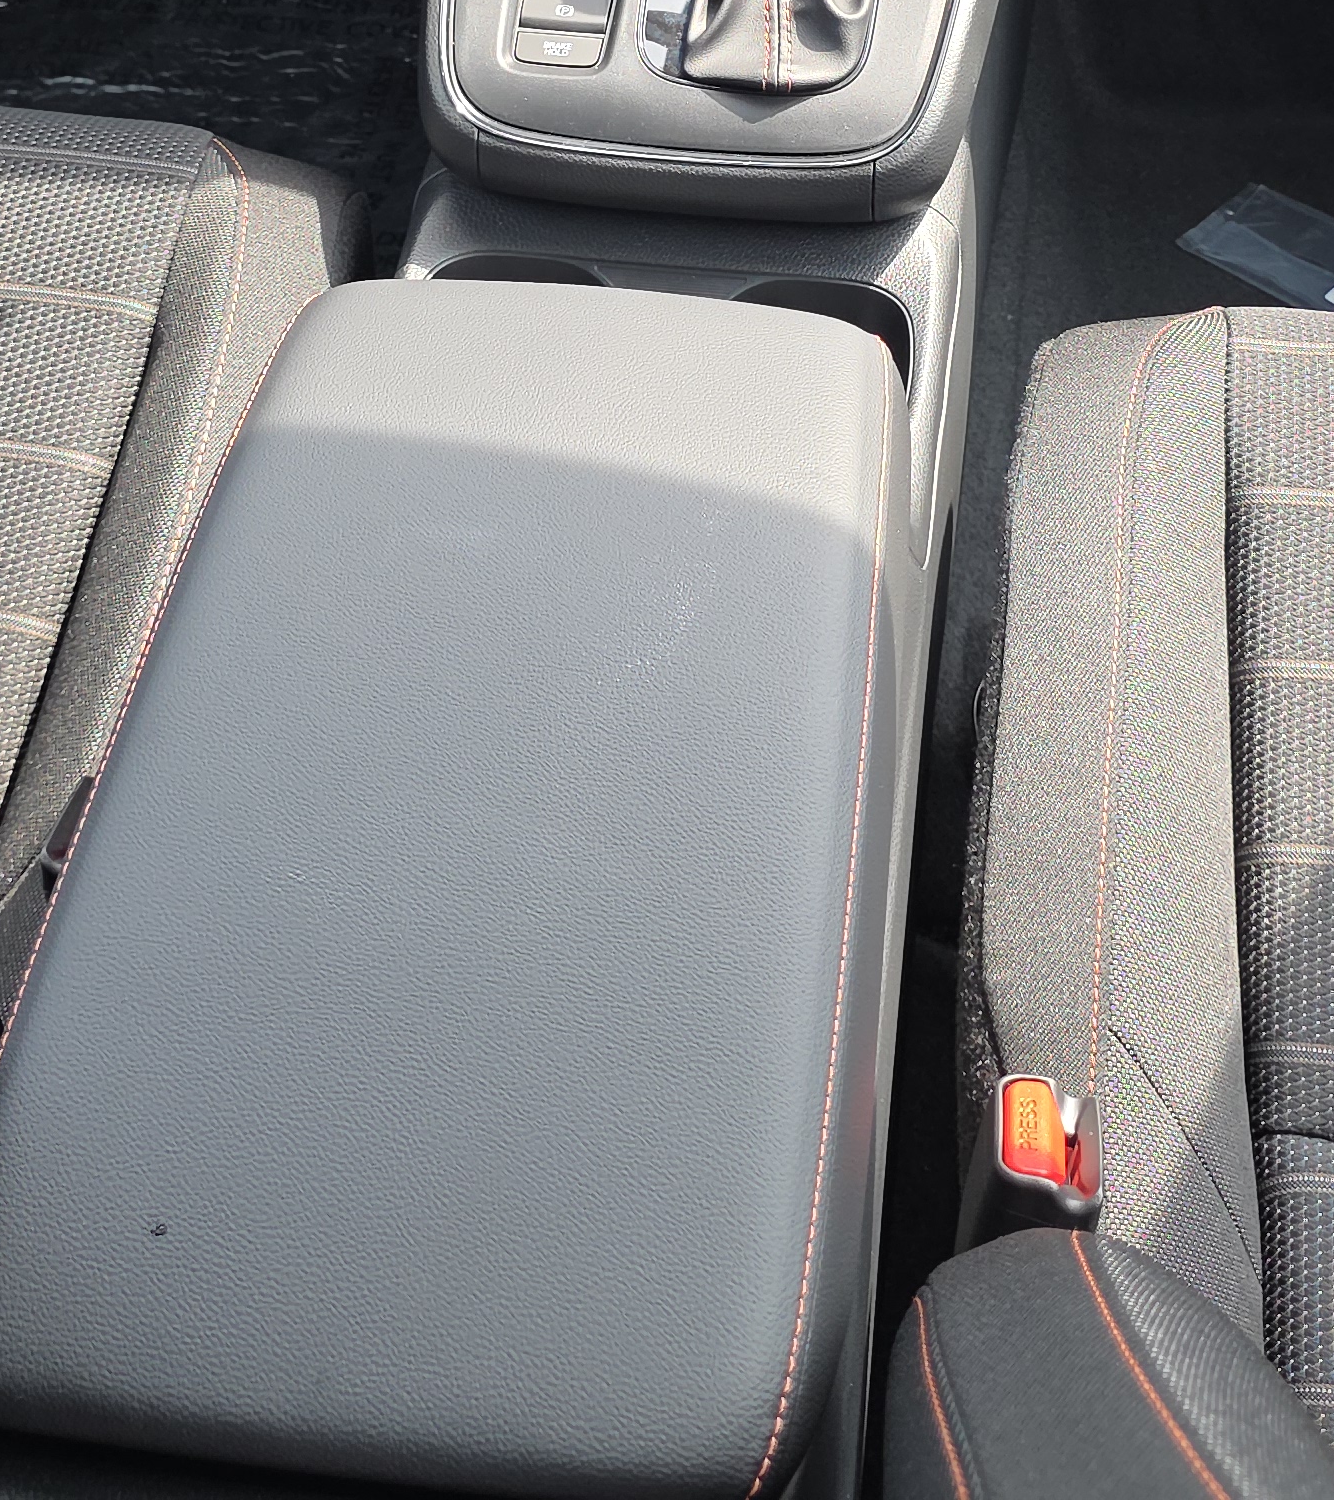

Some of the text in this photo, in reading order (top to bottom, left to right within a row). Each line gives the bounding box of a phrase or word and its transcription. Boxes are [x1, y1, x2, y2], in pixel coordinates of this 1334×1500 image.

[543, 41, 573, 50] BRAKE
[543, 48, 569, 57] HOLD
[1019, 1097, 1038, 1151] PRESS
